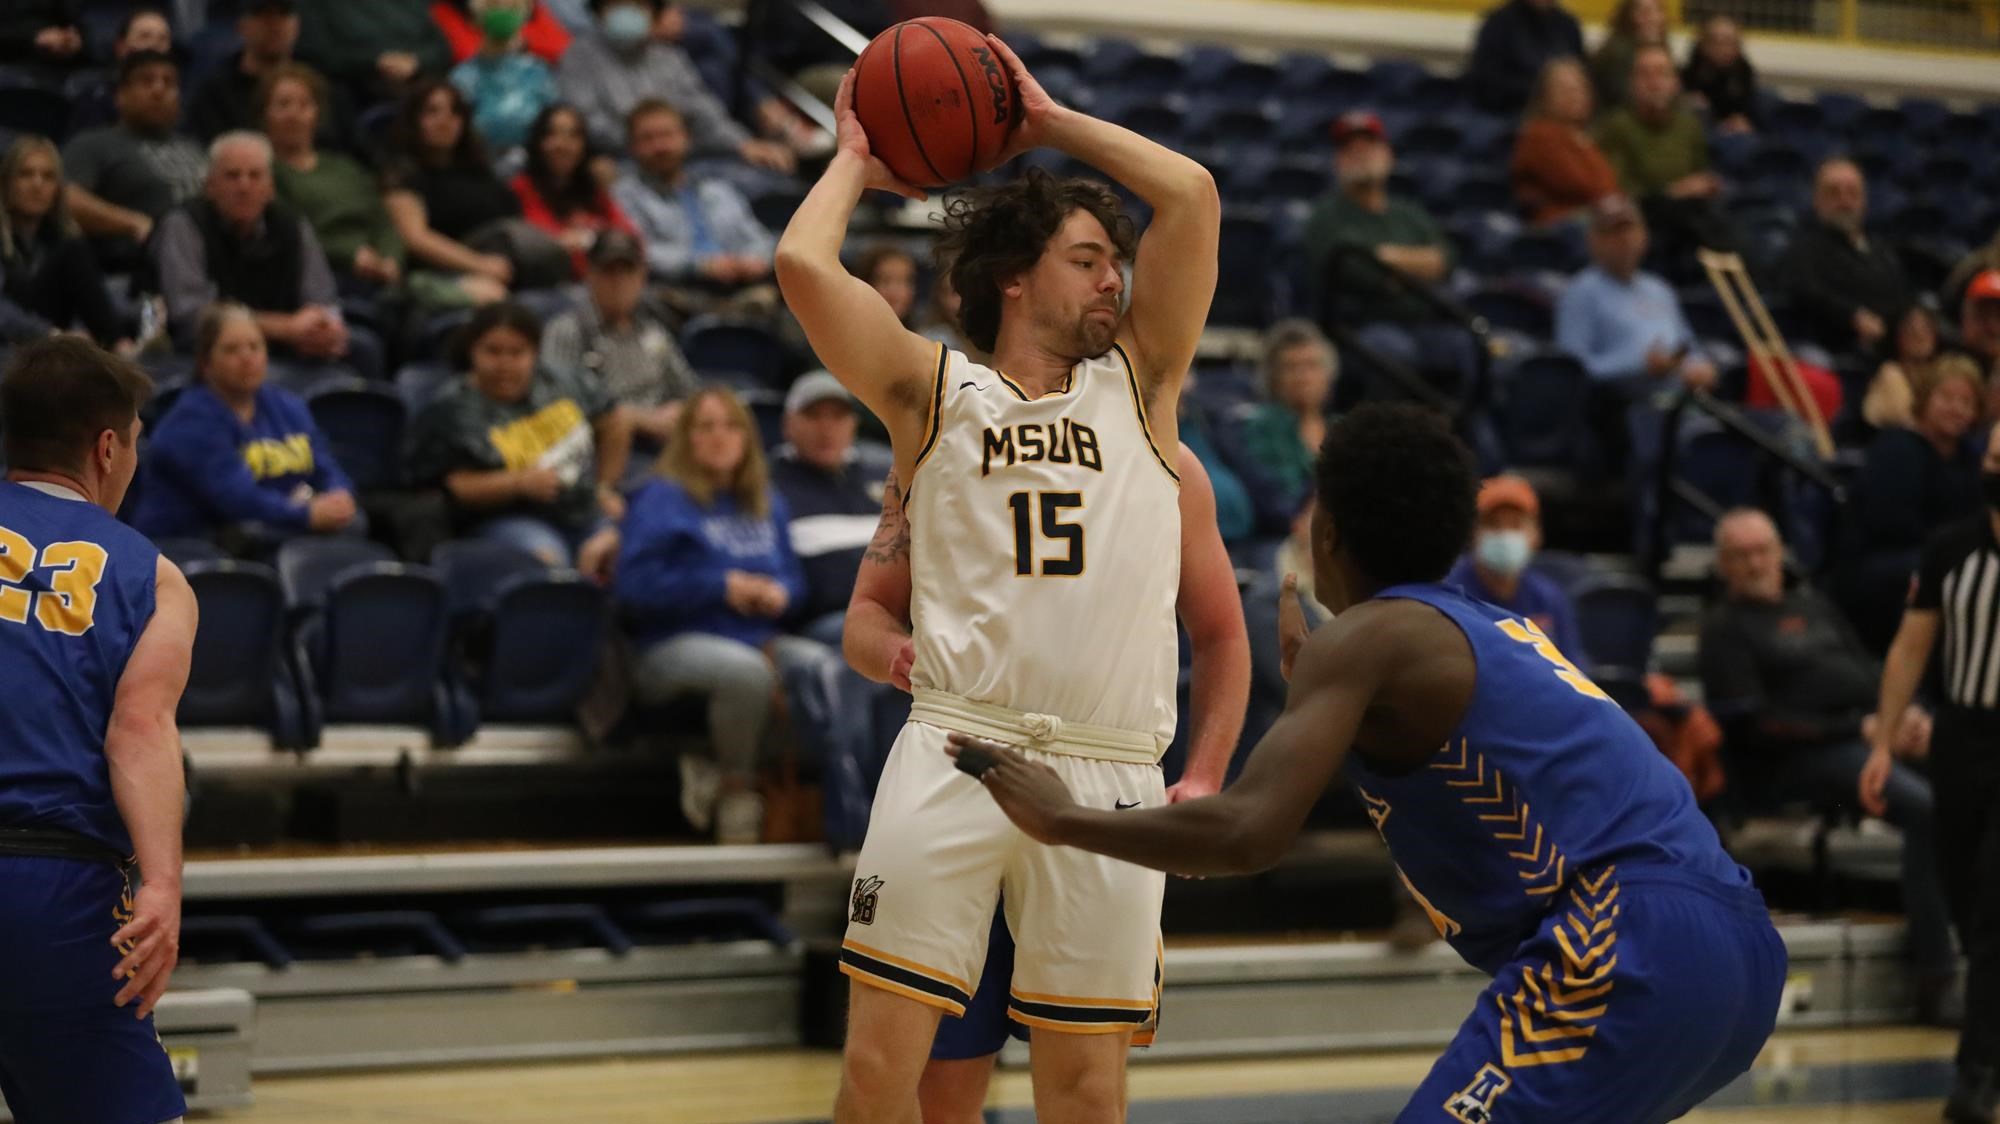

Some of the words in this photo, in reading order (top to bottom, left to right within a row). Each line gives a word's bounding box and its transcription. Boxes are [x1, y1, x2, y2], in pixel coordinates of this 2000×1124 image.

[970, 46, 1008, 125] NCAA
[981, 416, 1104, 480] MSUB
[1007, 489, 1086, 578] 15
[0, 525, 109, 637] 23
